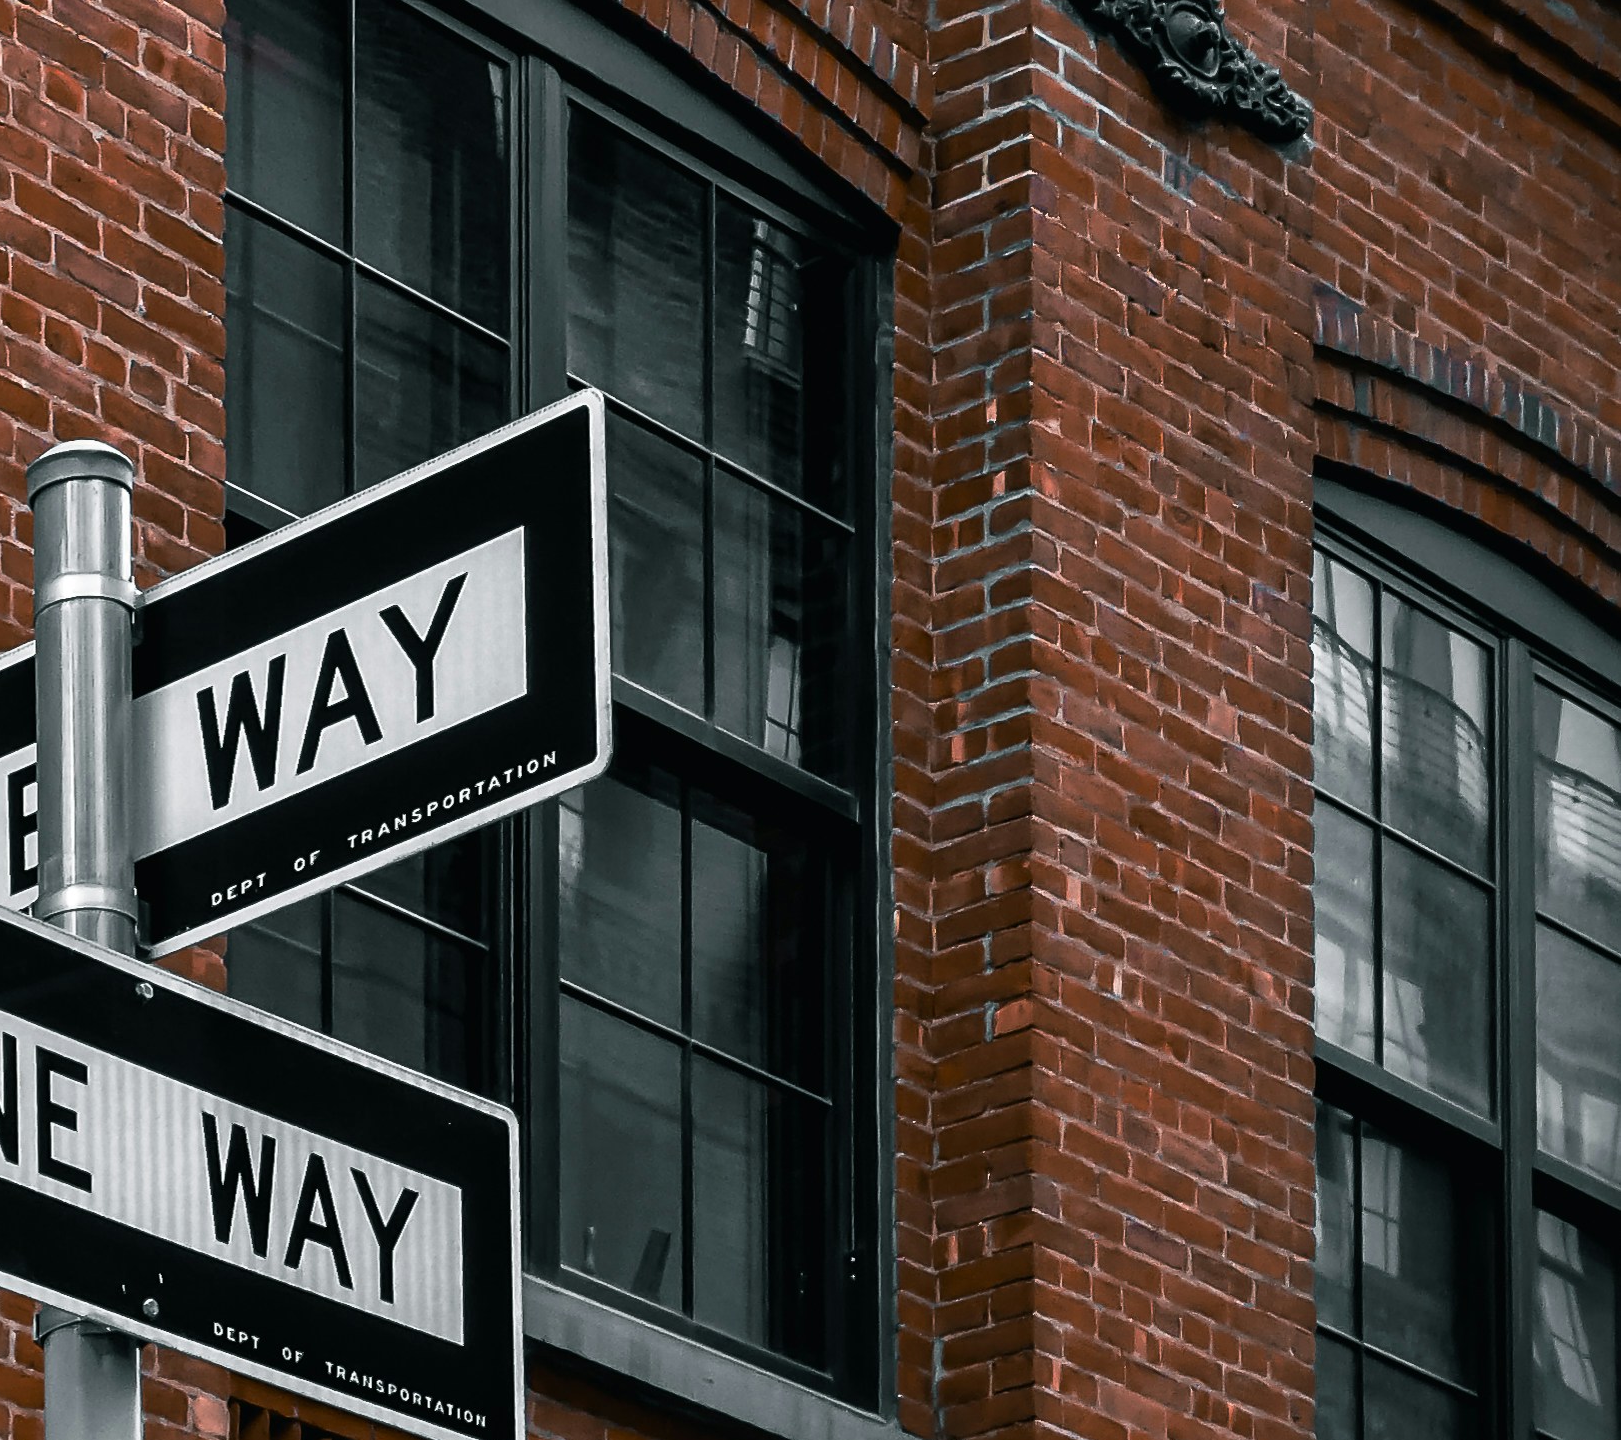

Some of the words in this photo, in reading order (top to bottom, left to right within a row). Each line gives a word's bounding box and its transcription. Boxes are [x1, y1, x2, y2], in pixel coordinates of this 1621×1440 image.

[196, 571, 469, 811] WAY
[210, 872, 268, 908] DEPT
[293, 849, 321, 873] OF
[347, 750, 558, 850] TRANSPORTATION
[201, 1110, 420, 1305] WAY
[213, 1322, 261, 1349] DEPT
[281, 1346, 305, 1363] OF
[324, 1361, 487, 1428] TRANSPORTATION
